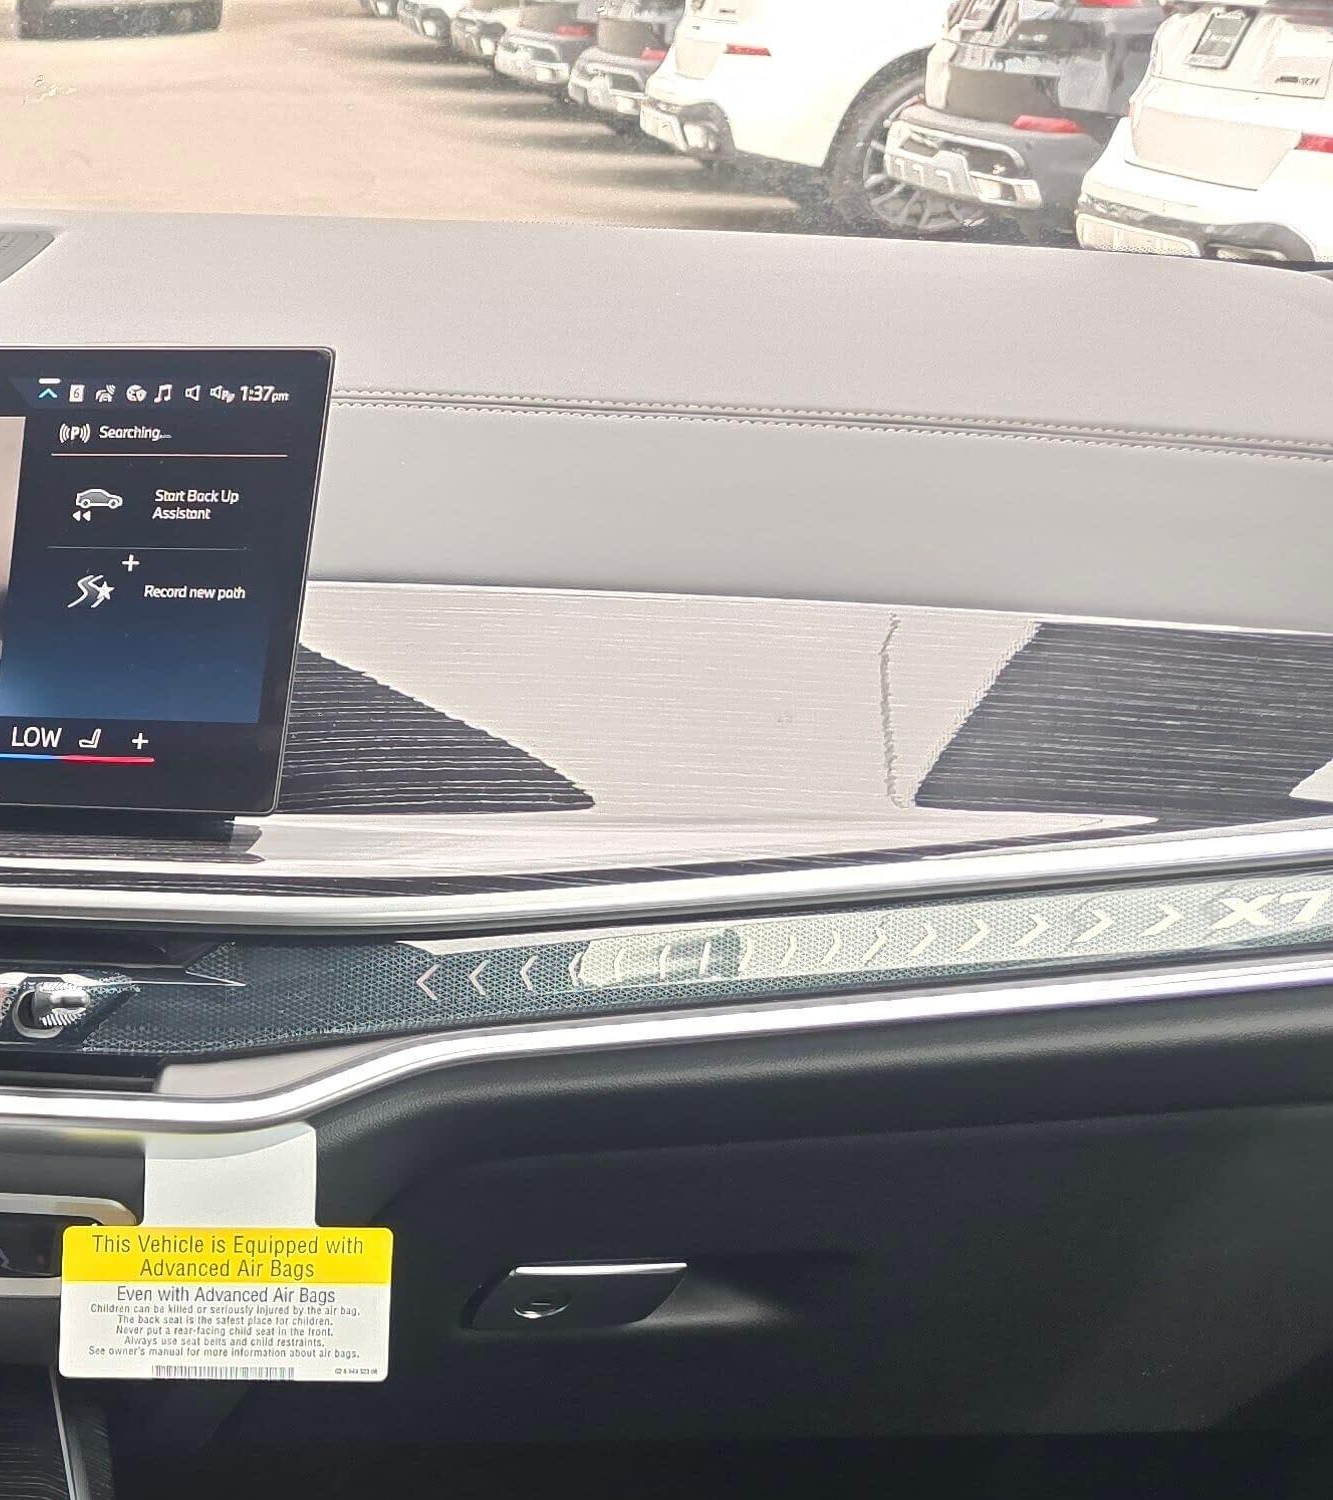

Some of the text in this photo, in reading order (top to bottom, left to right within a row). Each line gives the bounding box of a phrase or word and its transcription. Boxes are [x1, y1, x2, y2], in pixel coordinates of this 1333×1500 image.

[240, 385, 289, 403] 1:37pm
[155, 489, 240, 505] Start Back Up
[152, 507, 211, 520] Assistant
[144, 585, 246, 601] Record new path
[11, 726, 63, 748] LOW
[1213, 888, 1333, 930] X7
[92, 1235, 363, 1257] This Vehicle is Equipped with
[140, 1259, 315, 1281] Advanced Air Bags
[117, 1286, 336, 1305] Even with Advanced Air Bags
[90, 1303, 361, 1317] Children can be killed or seriously injured by the air bag.
[117, 1315, 334, 1326] The back seat is the safest place for children.
[116, 1325, 334, 1337] Never put a rear-facing child seat in the front.
[124, 1336, 157, 1346] Always
[181, 1337, 201, 1346] seat
[204, 1337, 227, 1346] belts
[230, 1337, 247, 1346] and
[250, 1337, 273, 1347] child
[277, 1338, 325, 1347] restraints.
[88, 1346, 360, 1359] See owner's manual for more information about air bags.
